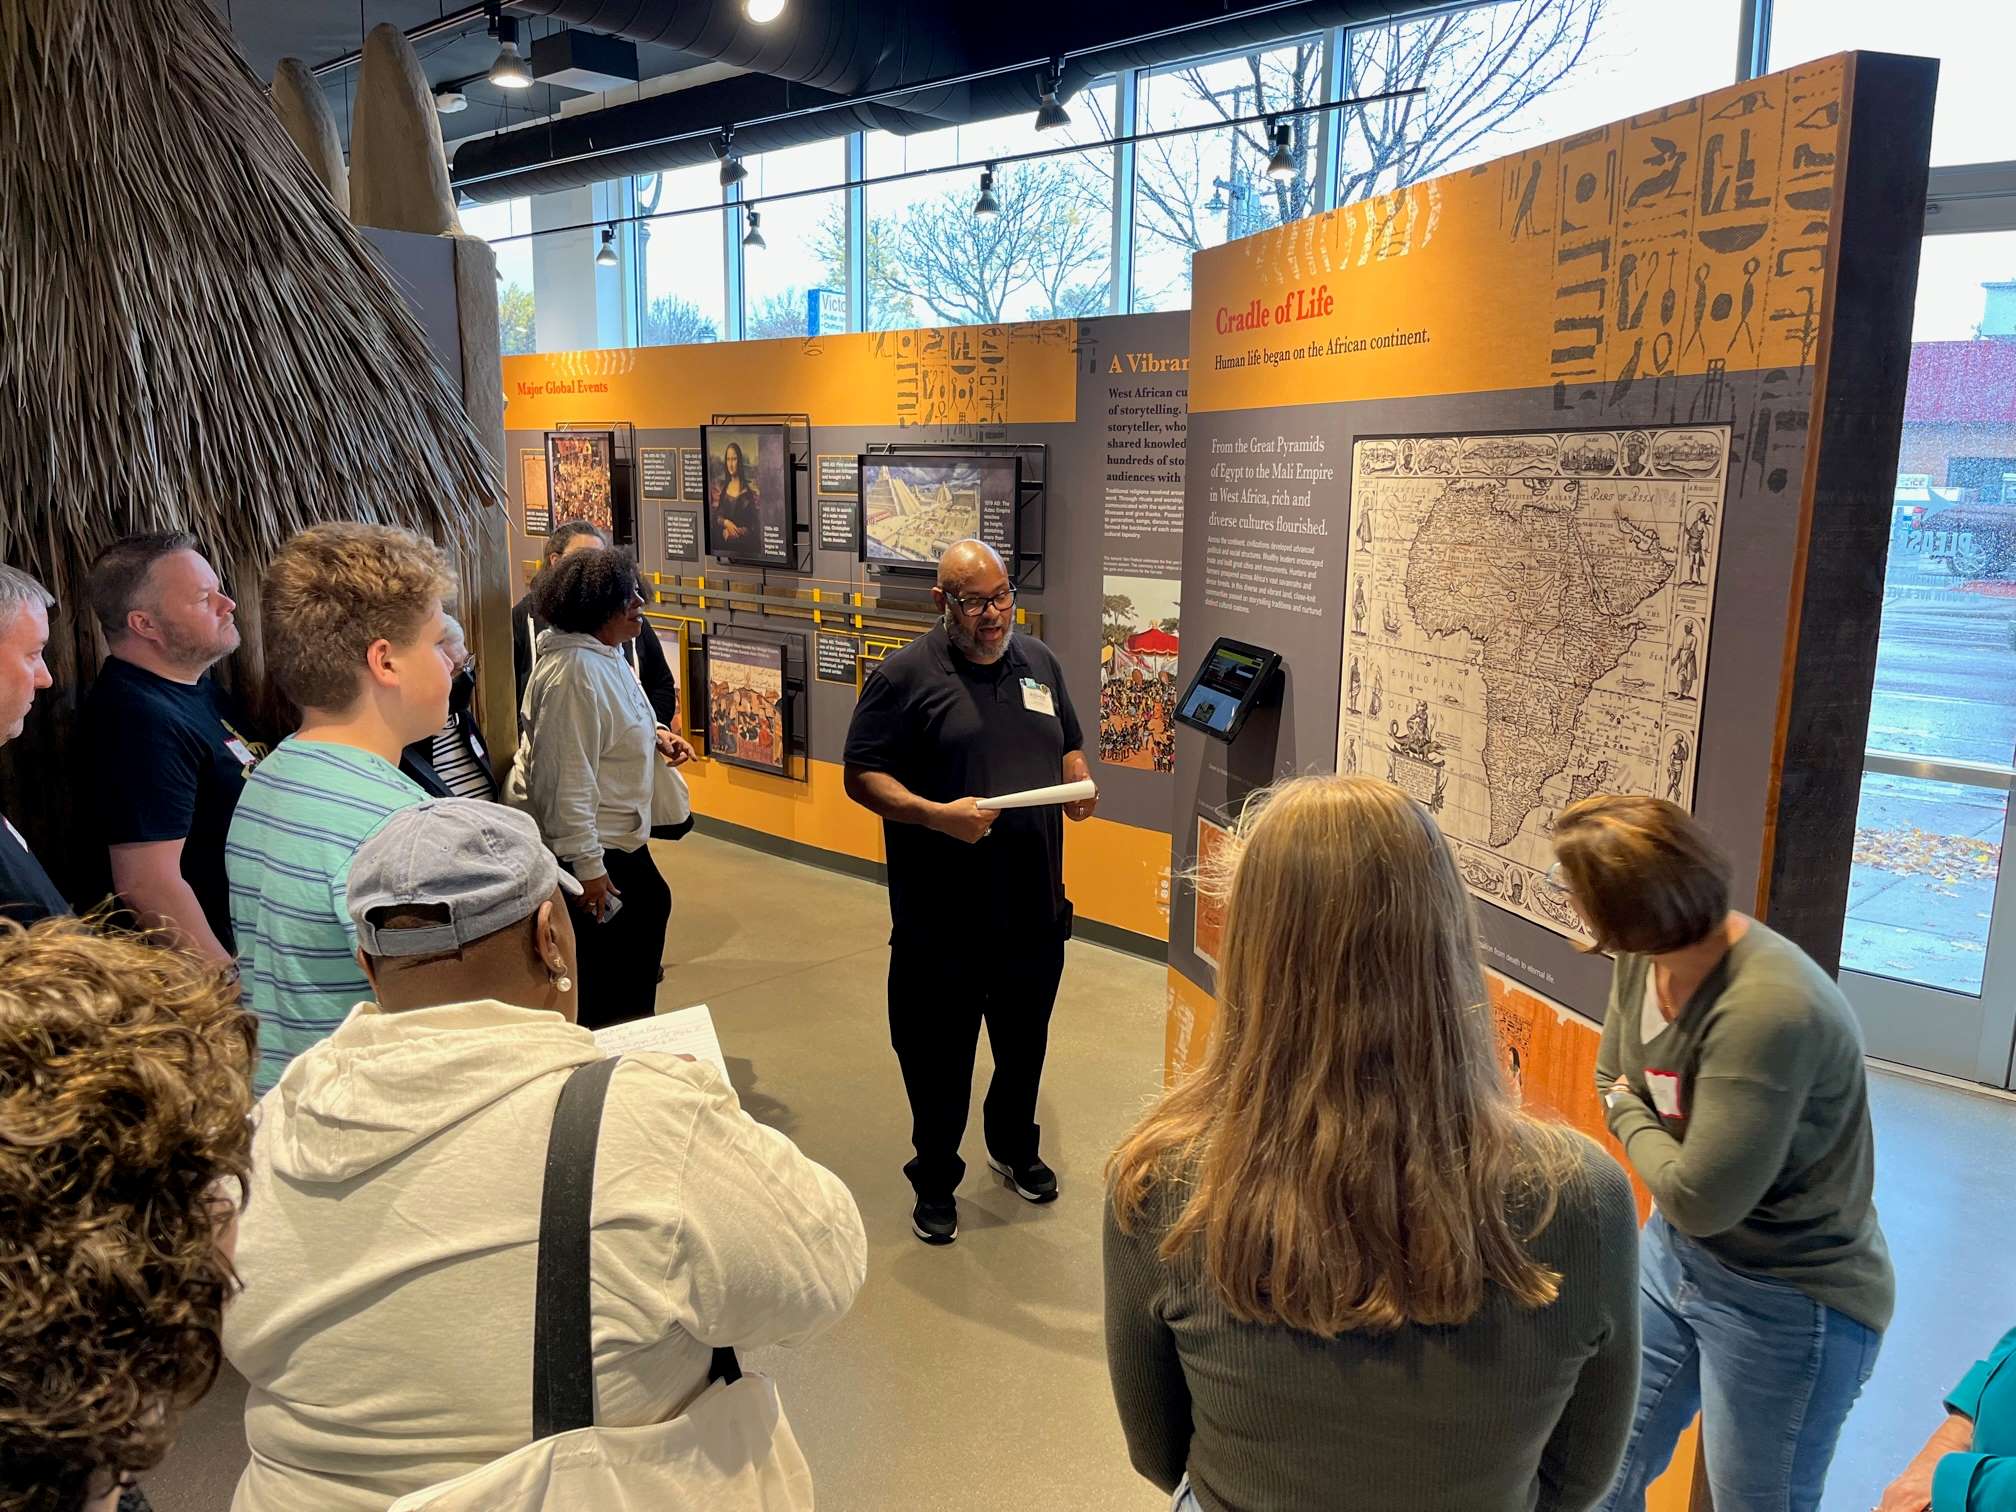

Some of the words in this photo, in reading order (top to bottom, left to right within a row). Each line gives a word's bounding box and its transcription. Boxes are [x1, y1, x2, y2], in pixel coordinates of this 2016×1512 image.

[1216, 299, 1270, 335] Cradle
[1275, 292, 1295, 324] of
[1297, 284, 1334, 321] Life
[1215, 354, 1245, 371] Human
[1247, 348, 1261, 366] life
[1263, 346, 1290, 368] began
[1293, 346, 1305, 359] on
[1308, 341, 1324, 357] the
[1326, 335, 1366, 355] African
[1370, 327, 1431, 348] continent.
[1108, 355, 1122, 374] A
[517, 382, 544, 399] Major
[545, 379, 576, 395] Global
[577, 379, 609, 394] Events
[1109, 388, 1132, 399] West
[1134, 386, 1172, 398] African
[1108, 405, 1120, 416] of
[1120, 403, 1181, 418] storytelling.
[1107, 423, 1162, 435] storyteller,
[1165, 423, 1186, 432] who
[1107, 439, 1141, 449] shared
[1212, 438, 1233, 454] From
[1235, 437, 1248, 452] the
[1250, 436, 1275, 453] Great
[1277, 435, 1325, 456] Pyramids
[1107, 454, 1154, 466] hundreds
[1157, 455, 1168, 466] of
[1106, 472, 1155, 483] audiences
[1158, 472, 1181, 483] with
[1211, 463, 1221, 478] of
[1221, 463, 1244, 483] Egypt
[1246, 466, 1253, 479] to
[1256, 464, 1270, 479] the
[1272, 463, 1294, 479] Mali
[1295, 463, 1334, 484] Empire
[1210, 489, 1217, 502] in
[1220, 488, 1239, 503] West
[1240, 488, 1269, 507] Africa,
[1272, 489, 1289, 506] rich
[1292, 490, 1311, 507] and
[1208, 512, 1237, 527] diverse
[1239, 514, 1275, 531] cultures
[1276, 515, 1328, 536] flourished.
